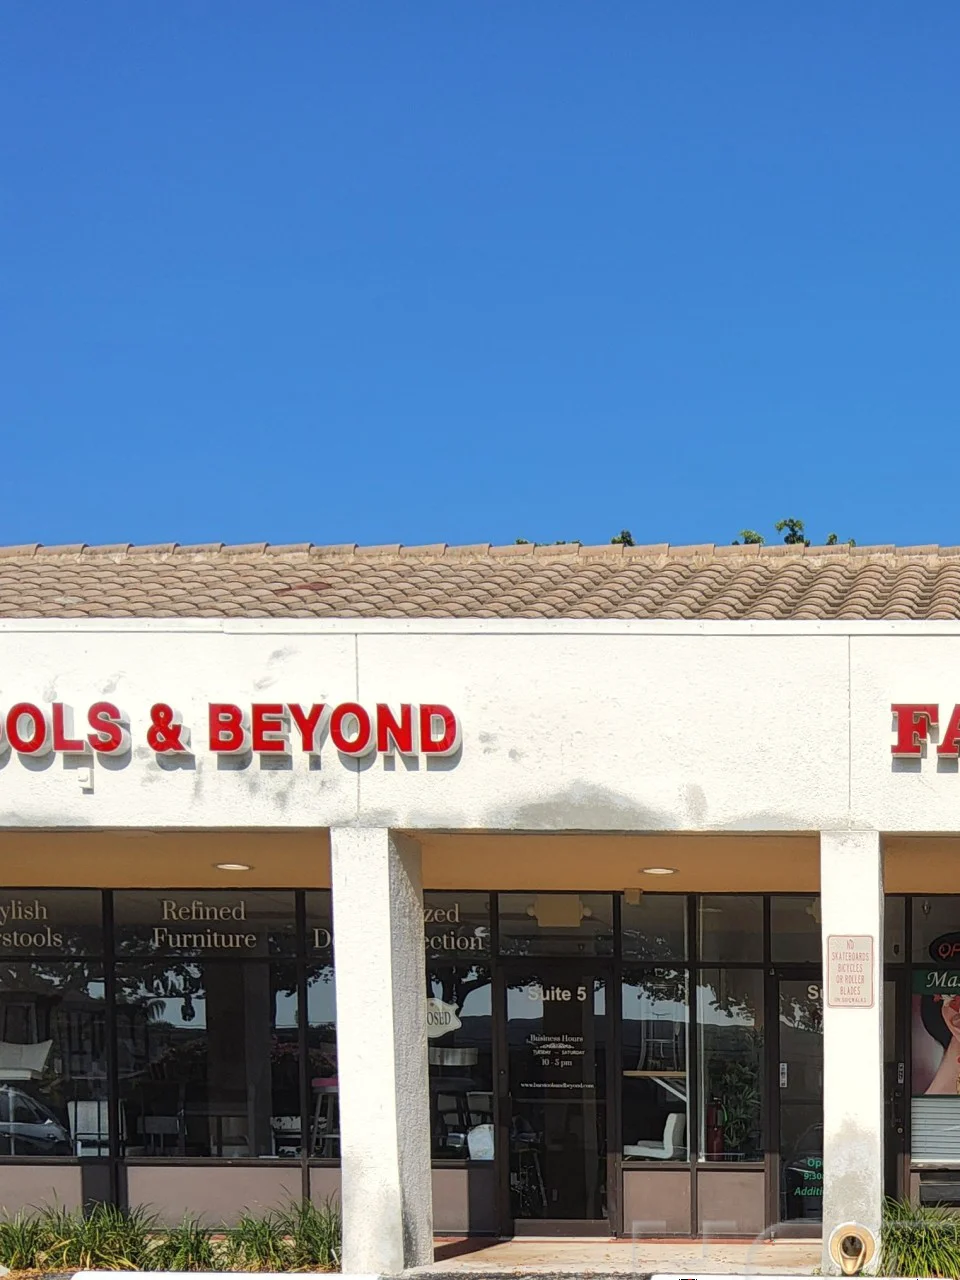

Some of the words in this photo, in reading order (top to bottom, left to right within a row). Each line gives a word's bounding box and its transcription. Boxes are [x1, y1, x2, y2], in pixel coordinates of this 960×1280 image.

[0, 701, 126, 755] OLS
[146, 702, 187, 753] &
[208, 703, 458, 754] BEYOND
[161, 900, 247, 921] Refined
[424, 903, 460, 923] zed
[152, 927, 257, 949] Furniture
[311, 928, 334, 949] D
[831, 952, 870, 962] SKATEBOARDS
[837, 963, 863, 973] BICYCLES
[845, 974, 865, 984] ROLLER
[528, 986, 571, 1002] Suite
[577, 986, 587, 1002] 5
[840, 986, 861, 996] BLADES
[530, 1034, 560, 1042] Business
[562, 1034, 584, 1042] Hours
[561, 1060, 573, 1068] pm
[807, 1158, 823, 1169] Op
[803, 1172, 824, 1180] 9:30
